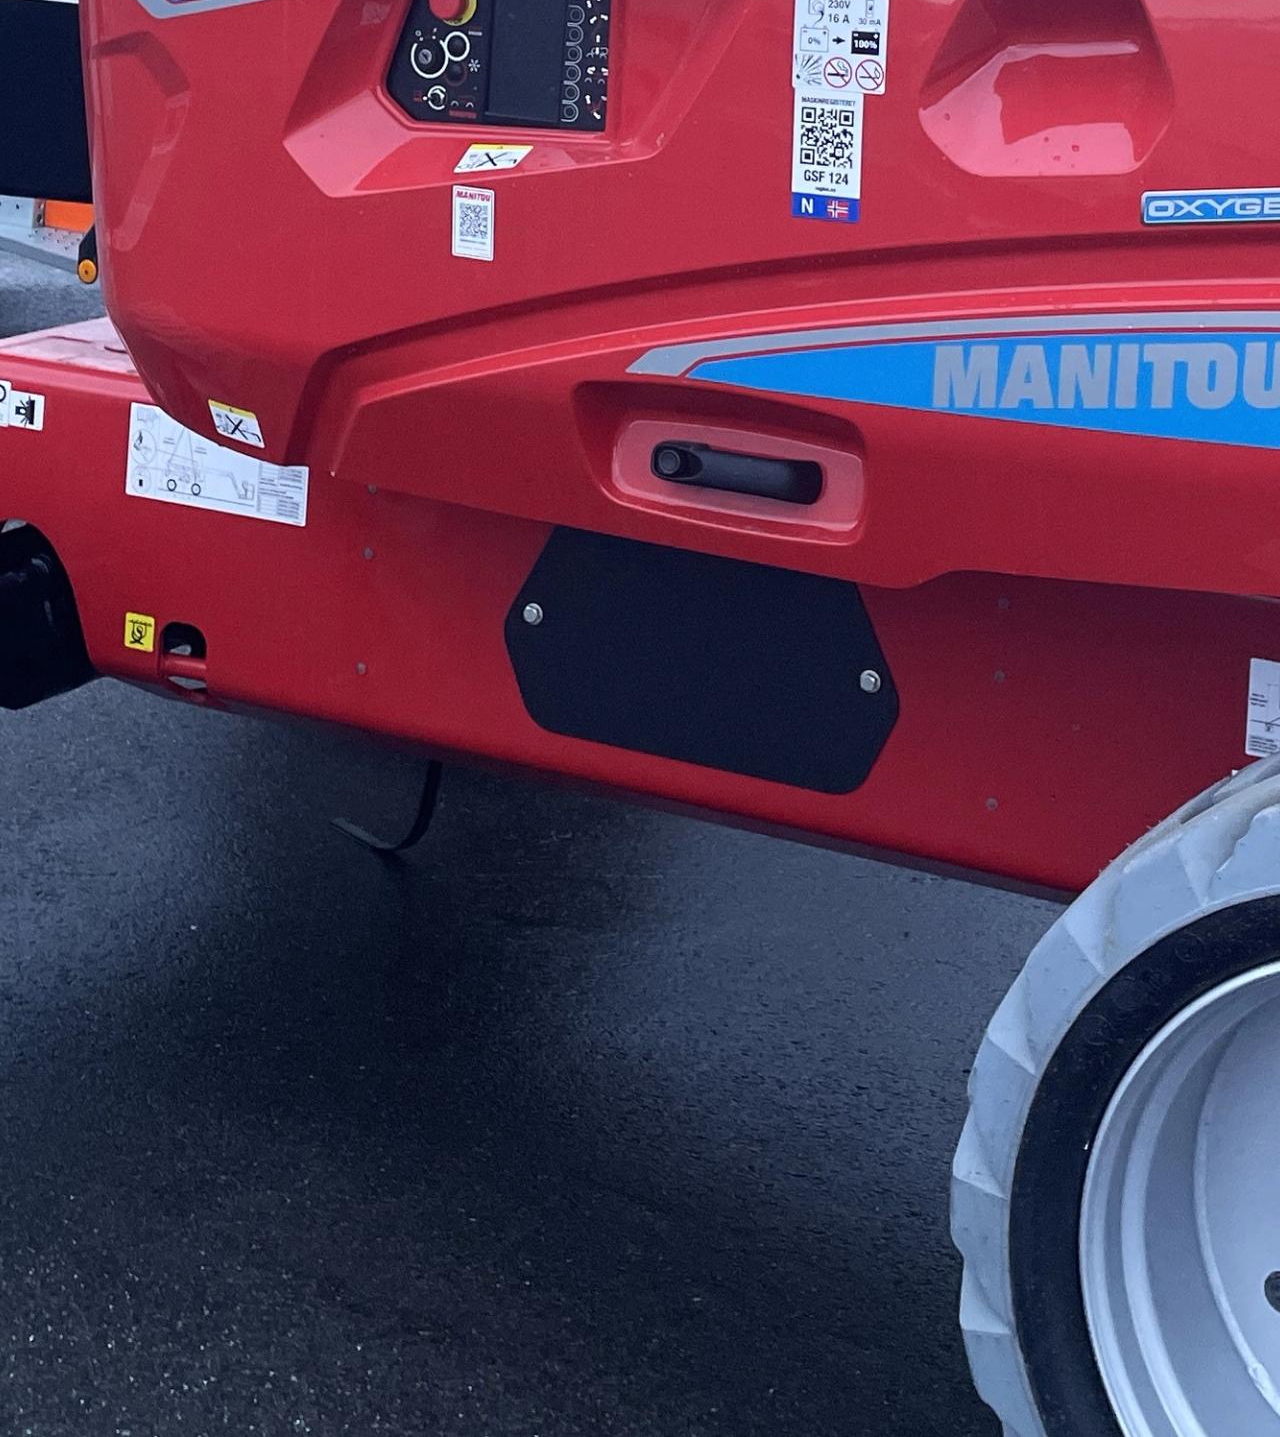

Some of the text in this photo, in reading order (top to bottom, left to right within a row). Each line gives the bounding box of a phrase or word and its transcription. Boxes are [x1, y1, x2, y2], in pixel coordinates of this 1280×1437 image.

[827, 0, 851, 9] 230V
[828, 13, 850, 24] 16 A
[853, 39, 878, 50] 100%
[803, 169, 849, 186] GSF 124
[455, 190, 491, 203] MANITOU
[801, 197, 814, 214] N
